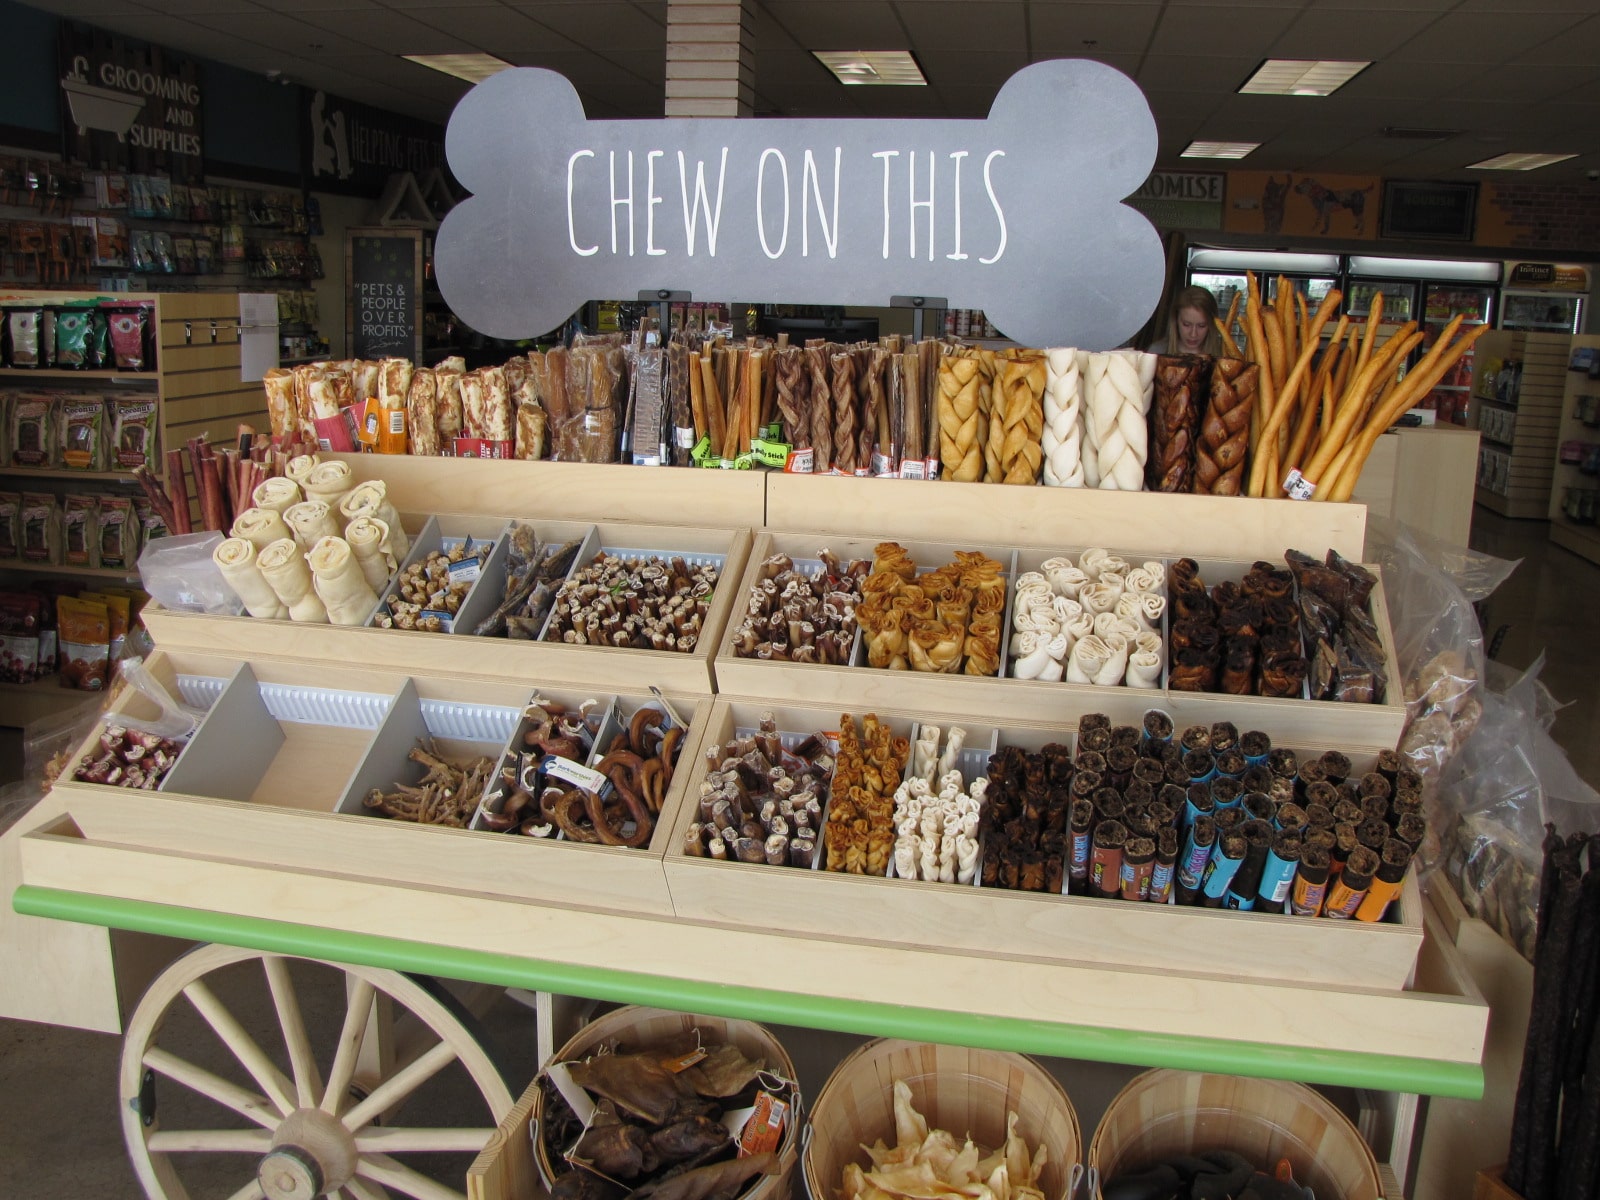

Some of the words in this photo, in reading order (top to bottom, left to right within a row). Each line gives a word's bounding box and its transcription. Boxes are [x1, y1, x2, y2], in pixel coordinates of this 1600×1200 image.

[101, 63, 200, 105] GROOMING
[165, 107, 194, 127] AND
[130, 123, 201, 156] SUPPLIES
[351, 119, 404, 168] HELPING
[567, 146, 729, 256] CHEW
[756, 146, 842, 259] ON
[871, 149, 1008, 265] THIS
[396, 284, 406, 296] &
[361, 297, 406, 310] PEOPLE
[362, 310, 405, 323] OVER
[64, 405, 99, 414] Coconut
[118, 404, 152, 415] Coconut
[767, 452, 784, 460] Stick
